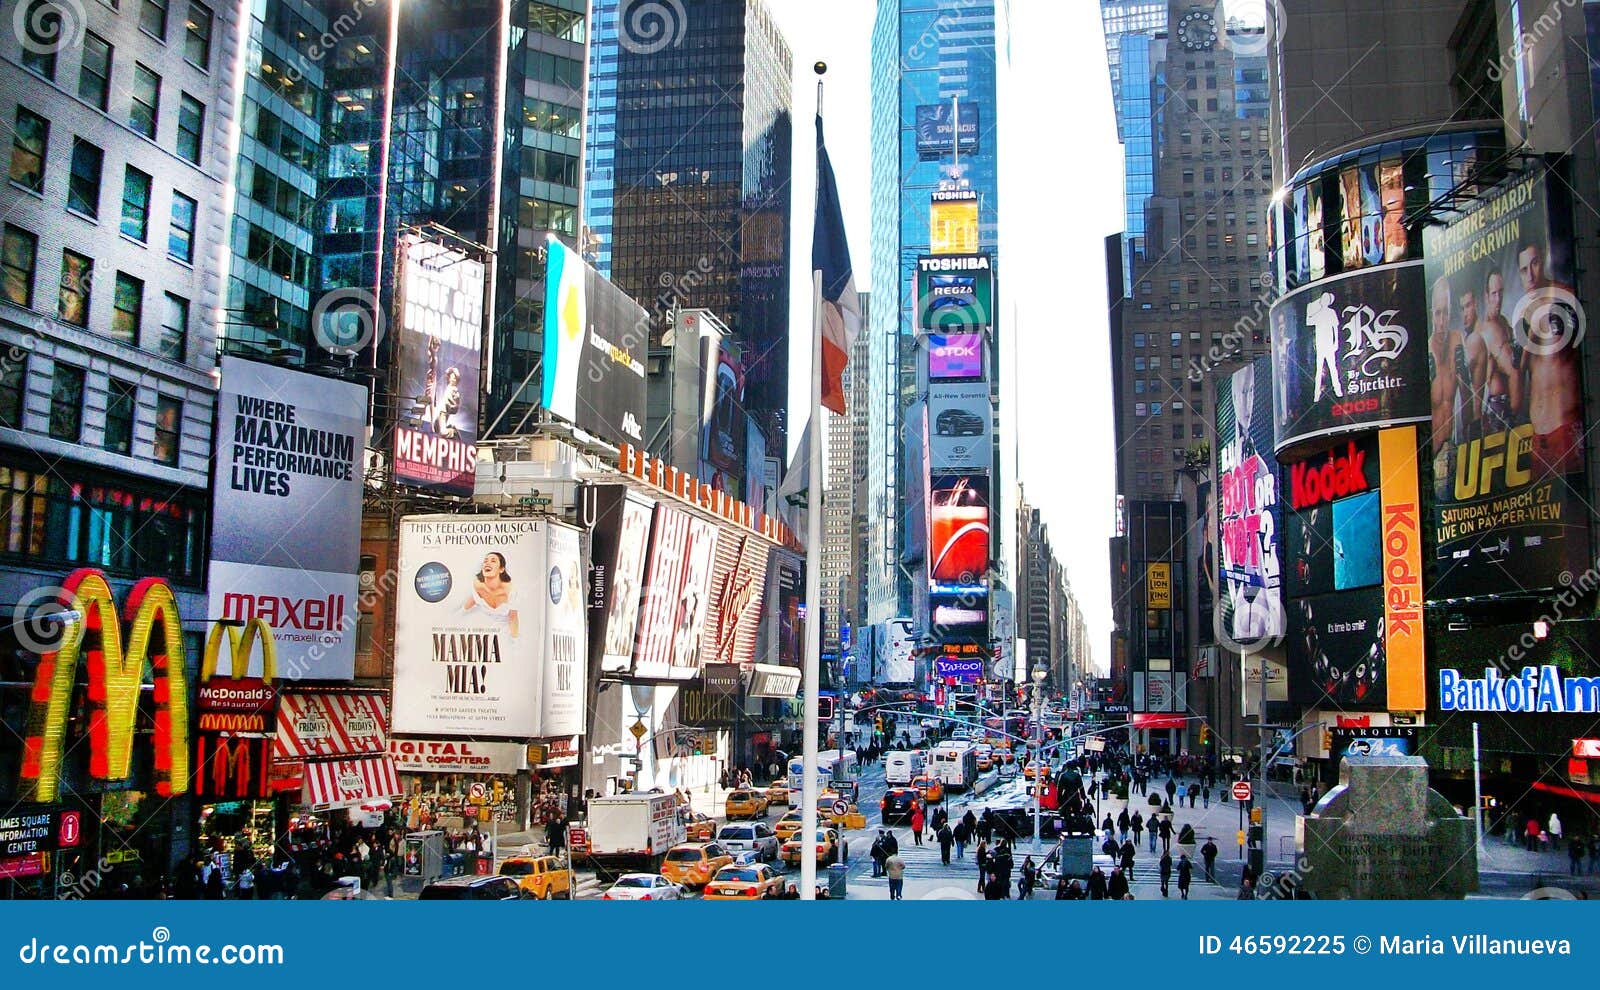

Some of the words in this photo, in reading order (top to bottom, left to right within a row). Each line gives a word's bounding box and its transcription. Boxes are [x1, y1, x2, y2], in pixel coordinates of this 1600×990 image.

[932, 191, 977, 200] TOSHIBA
[1492, 177, 1535, 221] HARDY
[1443, 250, 1466, 277] MIR
[1471, 218, 1521, 261] CARWIN
[919, 257, 989, 271] TOSHIBA
[934, 286, 973, 295] REGZA
[943, 346, 975, 357] TDK
[1347, 376, 1403, 395] Sheckler
[237, 394, 296, 424] WHERE
[233, 415, 355, 462] MAXIMUM
[396, 427, 477, 474] MEMPHIS
[232, 444, 354, 482] PERFORMANCE
[1454, 423, 1535, 501] UFC
[1290, 440, 1369, 510] Kodak
[231, 467, 291, 498] LIVES
[620, 443, 756, 530] BERTELSMANN
[1441, 503, 1491, 525] SATURDAY,
[1493, 492, 1533, 513] MARCH
[1536, 484, 1552, 504] 27
[410, 523, 433, 534] THIS
[436, 523, 491, 534] FEEL-GOOD
[494, 522, 541, 533] MUSICAL
[1437, 524, 1457, 543] LIVE
[1459, 521, 1475, 534] ON
[1478, 502, 1561, 530] PAY-PER-VIEW
[422, 535, 432, 544] IS
[434, 535, 442, 544] A
[1151, 570, 1165, 578] THE
[1384, 502, 1419, 637] Kodak
[594, 565, 605, 599] COMING
[1150, 580, 1168, 590] LION
[594, 600, 604, 609] IS
[1150, 592, 1169, 603] KING
[223, 592, 345, 632] maxell
[431, 633, 502, 663] MAMMA
[552, 633, 576, 662] MAMMA
[937, 662, 982, 672] YAHOO!
[445, 664, 487, 694] MIA!
[707, 678, 731, 686] FOREVER
[199, 687, 272, 700] McDonald's
[1439, 667, 1506, 712] Bank
[1504, 666, 1538, 712] of
[211, 700, 259, 708] Restaurant
[298, 721, 326, 732] FRIDAY'S
[348, 721, 373, 731] FRIDAY'S
[1336, 728, 1414, 736] MARQUIS
[389, 741, 473, 756] IGITAL
[426, 755, 490, 765] COMPUTERS
[21, 814, 51, 828] SQUARE
[0, 827, 49, 841] NFORMATION
[7, 841, 37, 853] CENTER
